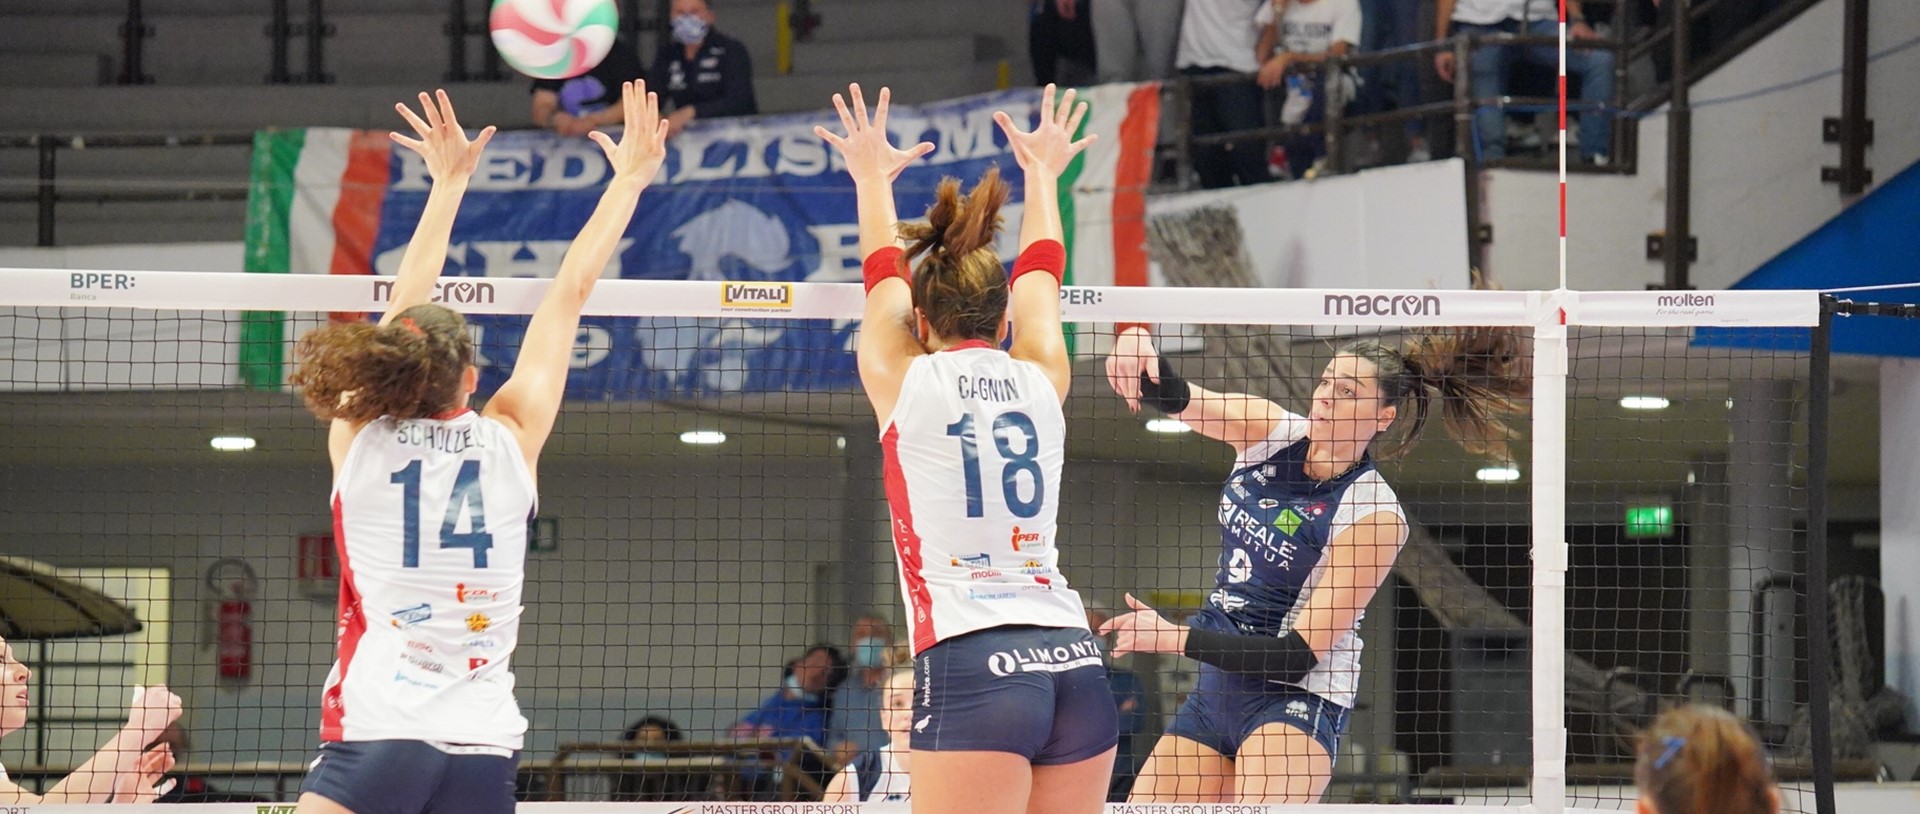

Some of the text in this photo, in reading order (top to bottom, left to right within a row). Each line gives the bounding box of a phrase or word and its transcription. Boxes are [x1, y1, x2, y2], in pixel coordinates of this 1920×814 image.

[70, 273, 135, 289] BPER:
[70, 293, 97, 301] Banca
[1324, 295, 1440, 316] macron
[1658, 293, 1714, 307] molten
[958, 375, 1019, 402] CAGNIN
[946, 411, 1044, 518] 18
[390, 459, 493, 568] 14
[1231, 525, 1290, 571] MUTUA
[1234, 509, 1297, 560] REALE
[1228, 548, 1253, 583] 9
[1013, 641, 1103, 663] LIMONTA
